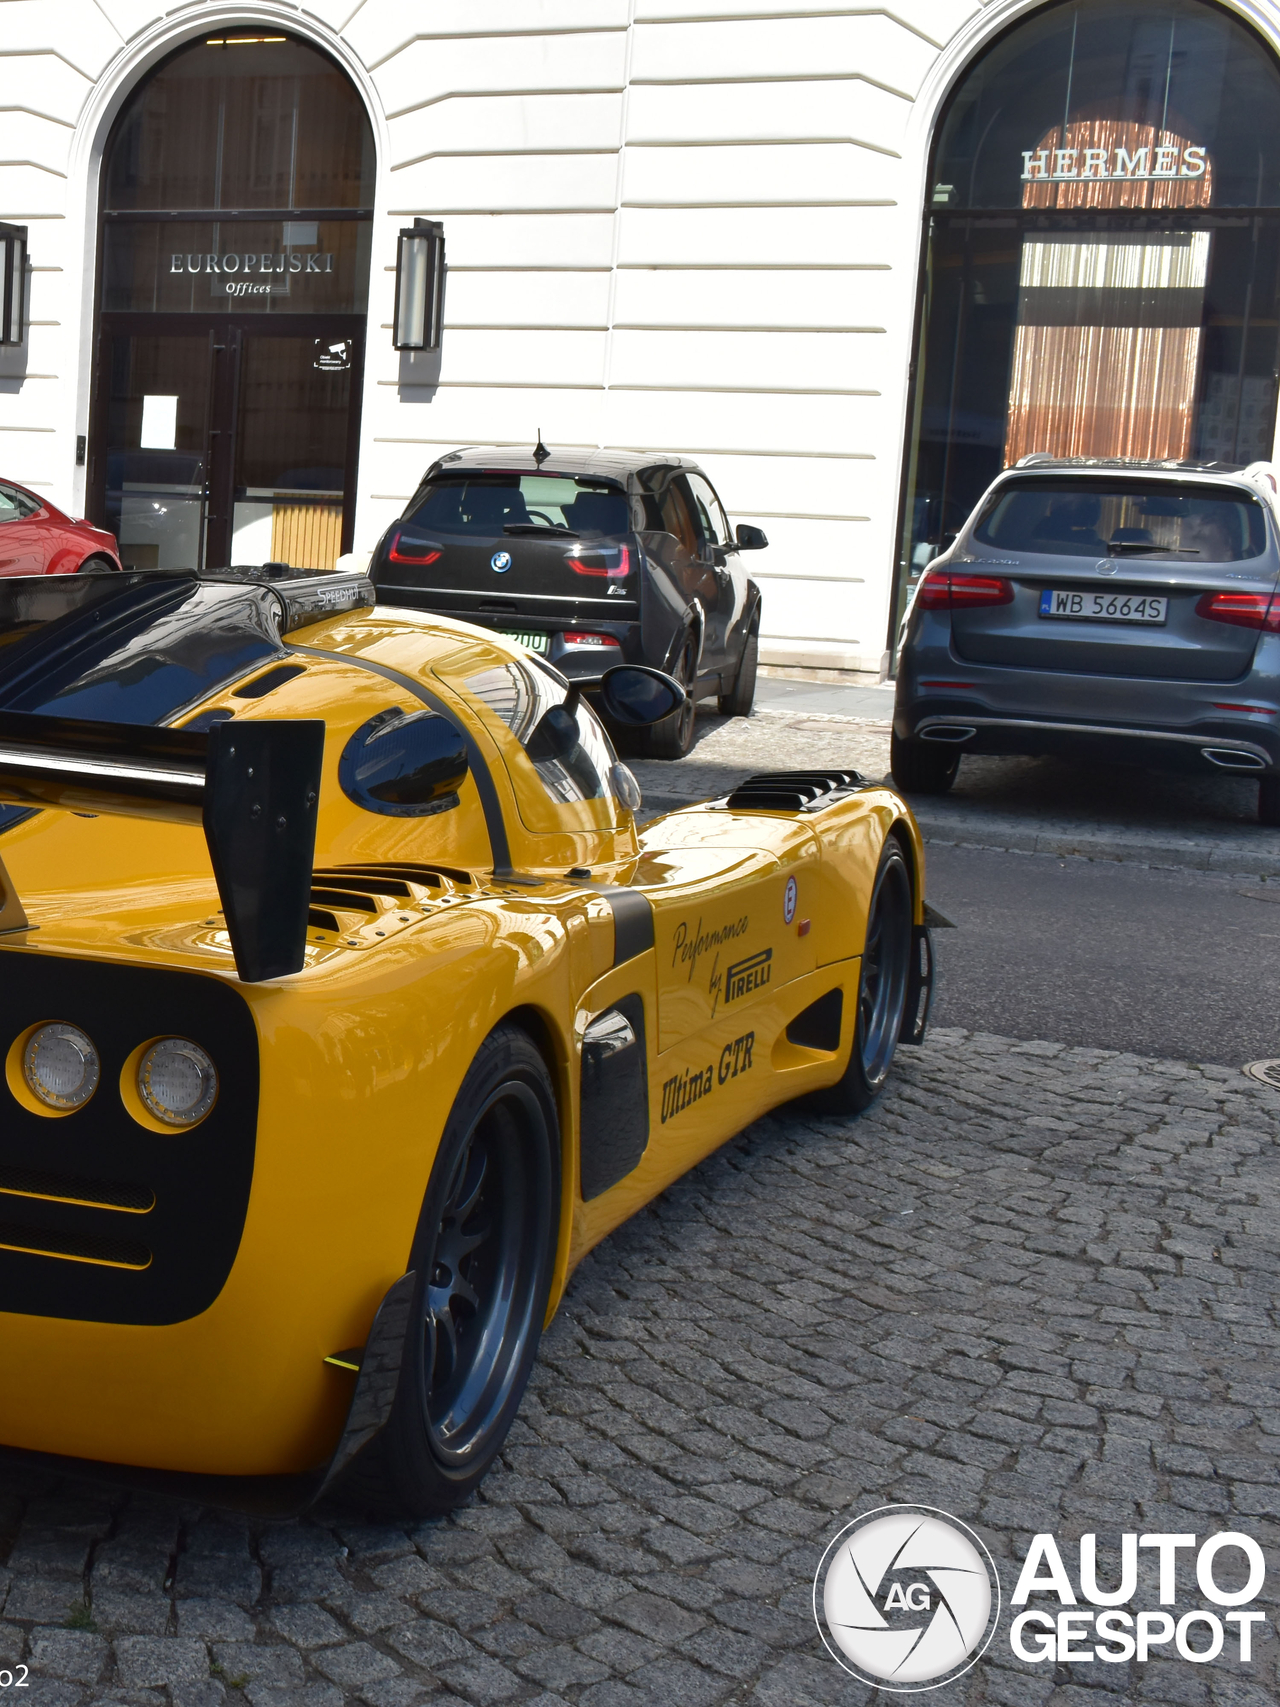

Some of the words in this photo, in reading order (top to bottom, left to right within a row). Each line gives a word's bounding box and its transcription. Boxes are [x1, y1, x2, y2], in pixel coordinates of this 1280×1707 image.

[169, 253, 335, 273] EUROPEJSKI
[225, 282, 272, 296] Offices
[1056, 593, 1083, 614] WB
[1091, 595, 1162, 619] 5664S
[500, 630, 542, 650] 200
[672, 915, 748, 983] Performance
[708, 951, 722, 1019] by
[724, 947, 773, 1004] PIRELLI
[661, 1064, 714, 1125] Ultima
[717, 1030, 755, 1086] GTR
